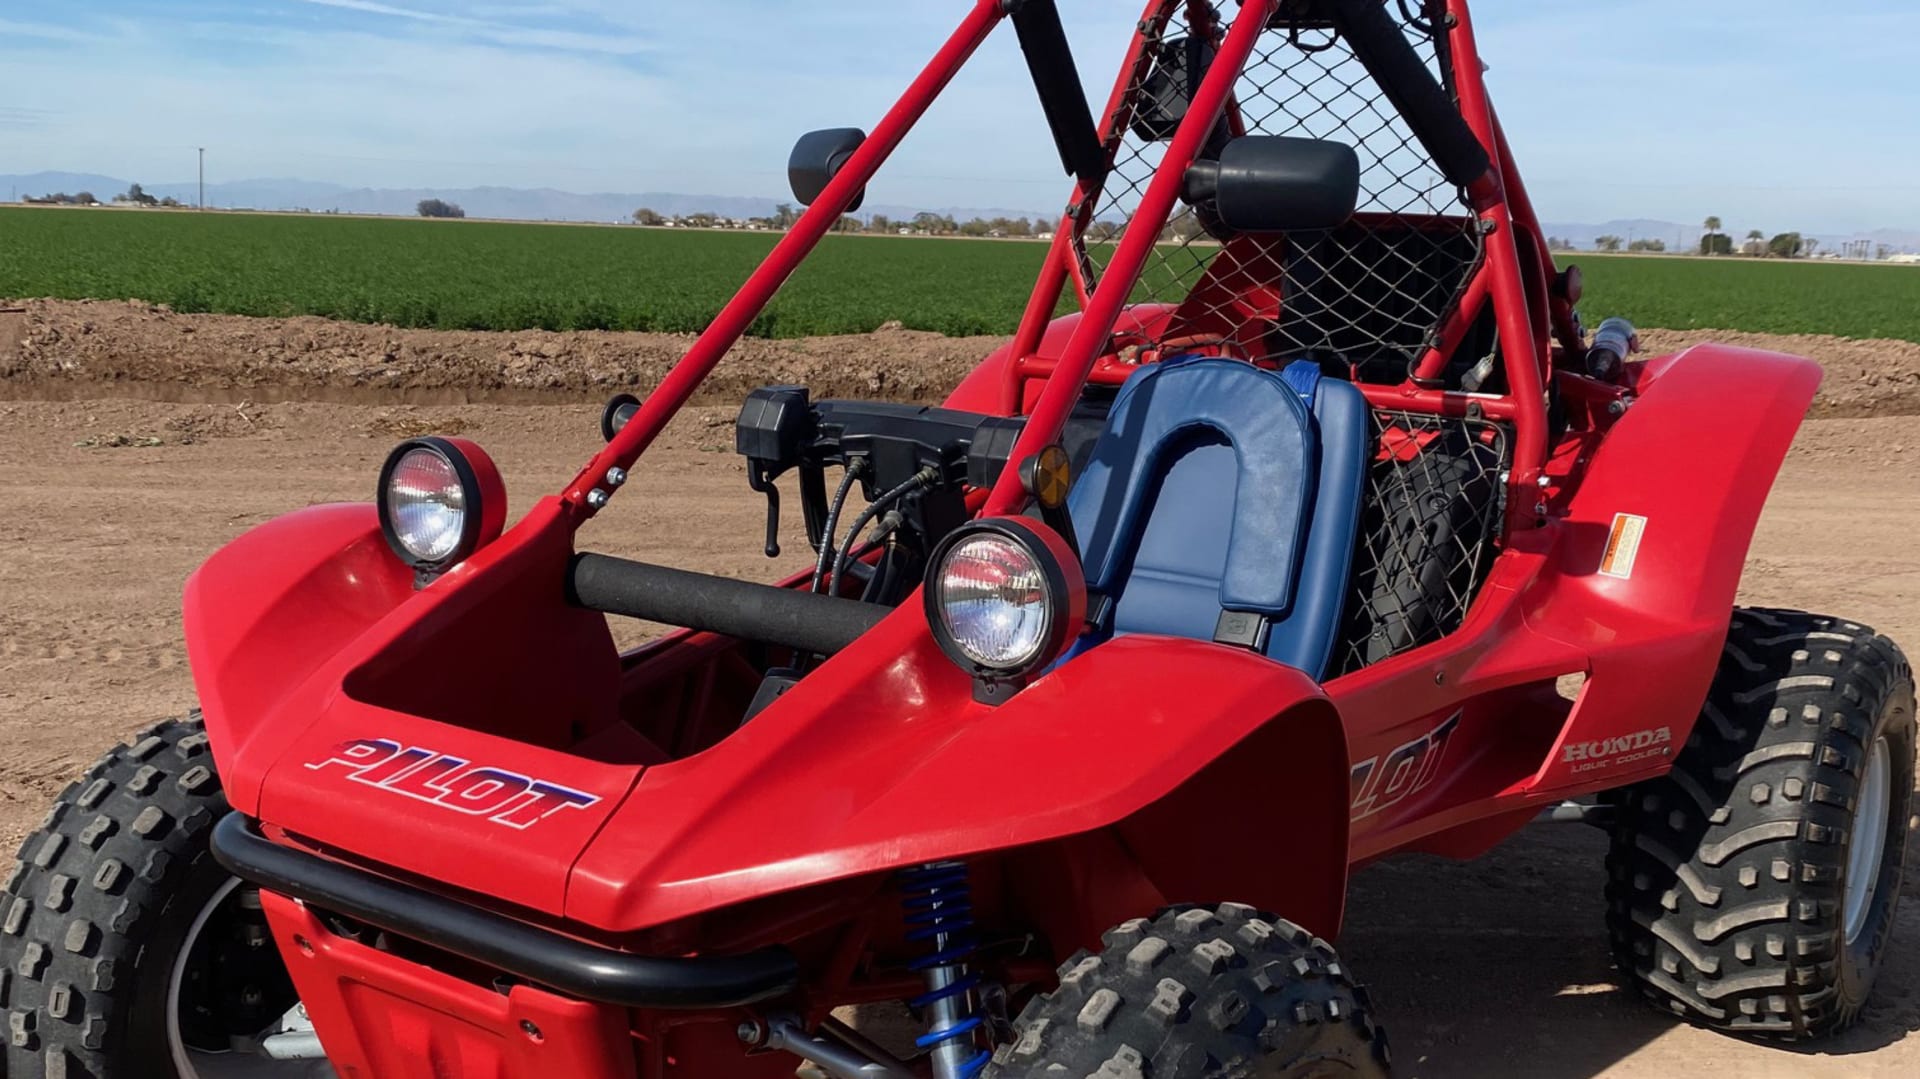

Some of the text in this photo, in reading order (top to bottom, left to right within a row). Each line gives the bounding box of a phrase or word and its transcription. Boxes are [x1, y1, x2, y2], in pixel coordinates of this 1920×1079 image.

[1562, 727, 1671, 762] HONDA
[1616, 747, 1662, 765] COOLED
[304, 738, 602, 829] PILOT
